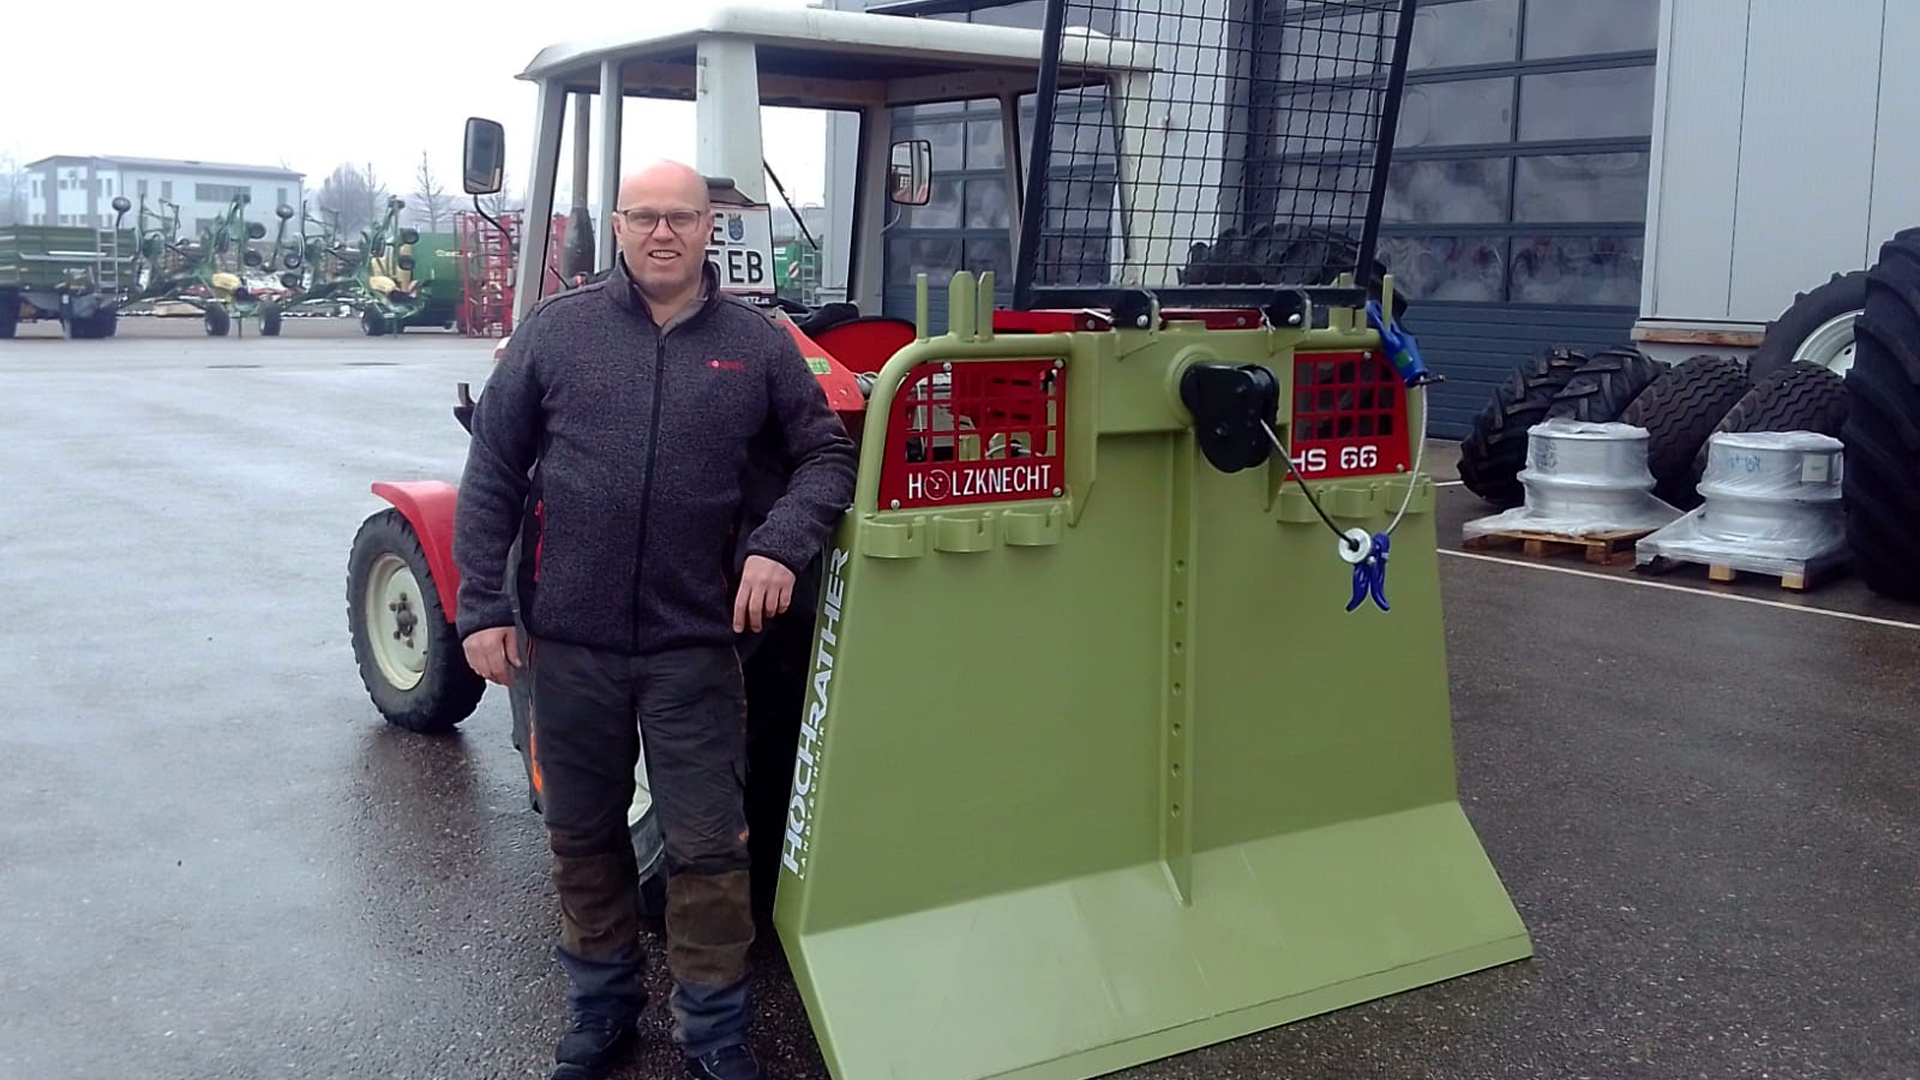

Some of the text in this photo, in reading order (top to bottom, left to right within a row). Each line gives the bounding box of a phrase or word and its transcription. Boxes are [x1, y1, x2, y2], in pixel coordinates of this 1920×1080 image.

[908, 464, 1052, 501] HOLZKNECHT
[1340, 445, 1378, 470] 66
[783, 547, 849, 875] HOCHRATHER
[798, 725, 826, 882] LANDTECHNIK
